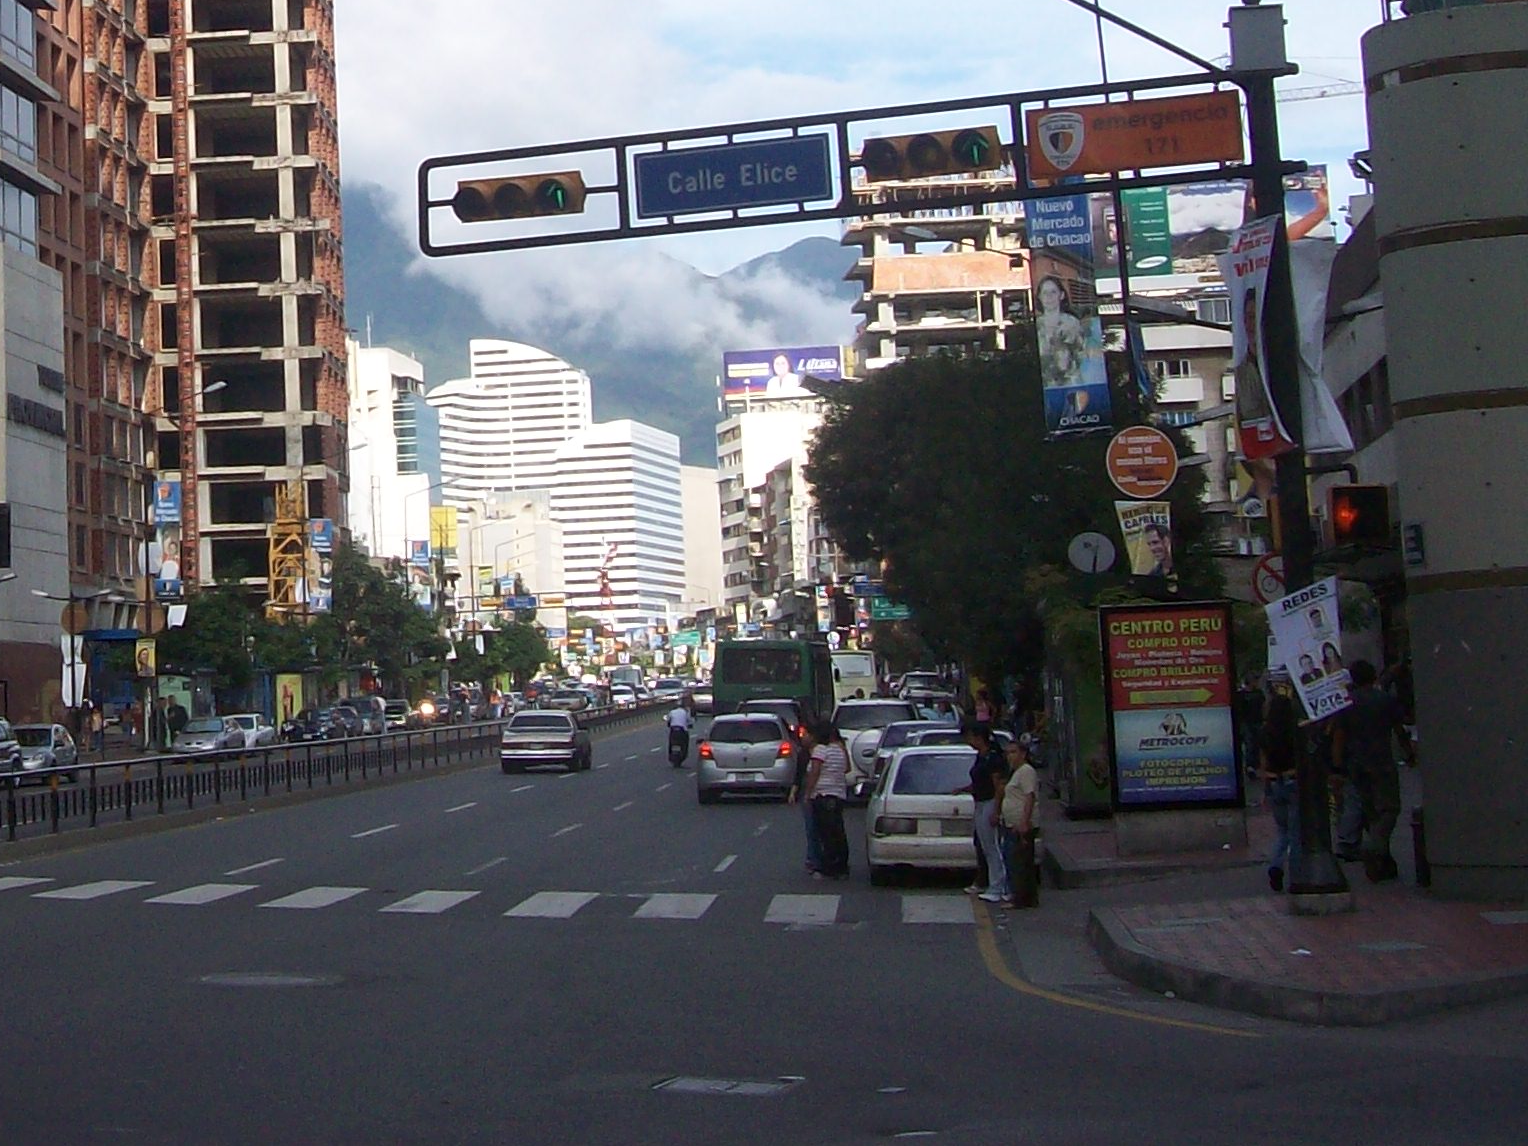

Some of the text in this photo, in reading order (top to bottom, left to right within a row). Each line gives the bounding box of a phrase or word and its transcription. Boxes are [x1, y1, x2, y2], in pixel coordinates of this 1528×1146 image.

[1092, 104, 1228, 130] emergencia
[1144, 135, 1179, 154] 171
[667, 162, 798, 194] Calle Elice
[1036, 200, 1074, 213] Nuevo
[1032, 215, 1084, 230] Mercado
[1029, 233, 1091, 248] de Chacao
[1282, 584, 1328, 611] REDES
[1110, 616, 1222, 635] CENTRO PERÚ
[1127, 636, 1207, 648] COMPRO ORO
[1113, 665, 1225, 678] COMPRO BRILLANTES
[1139, 736, 1209, 747] METROCOPY
[1140, 758, 1210, 768] FOTOCOPIAS
[1168, 768, 1183, 776] DE
